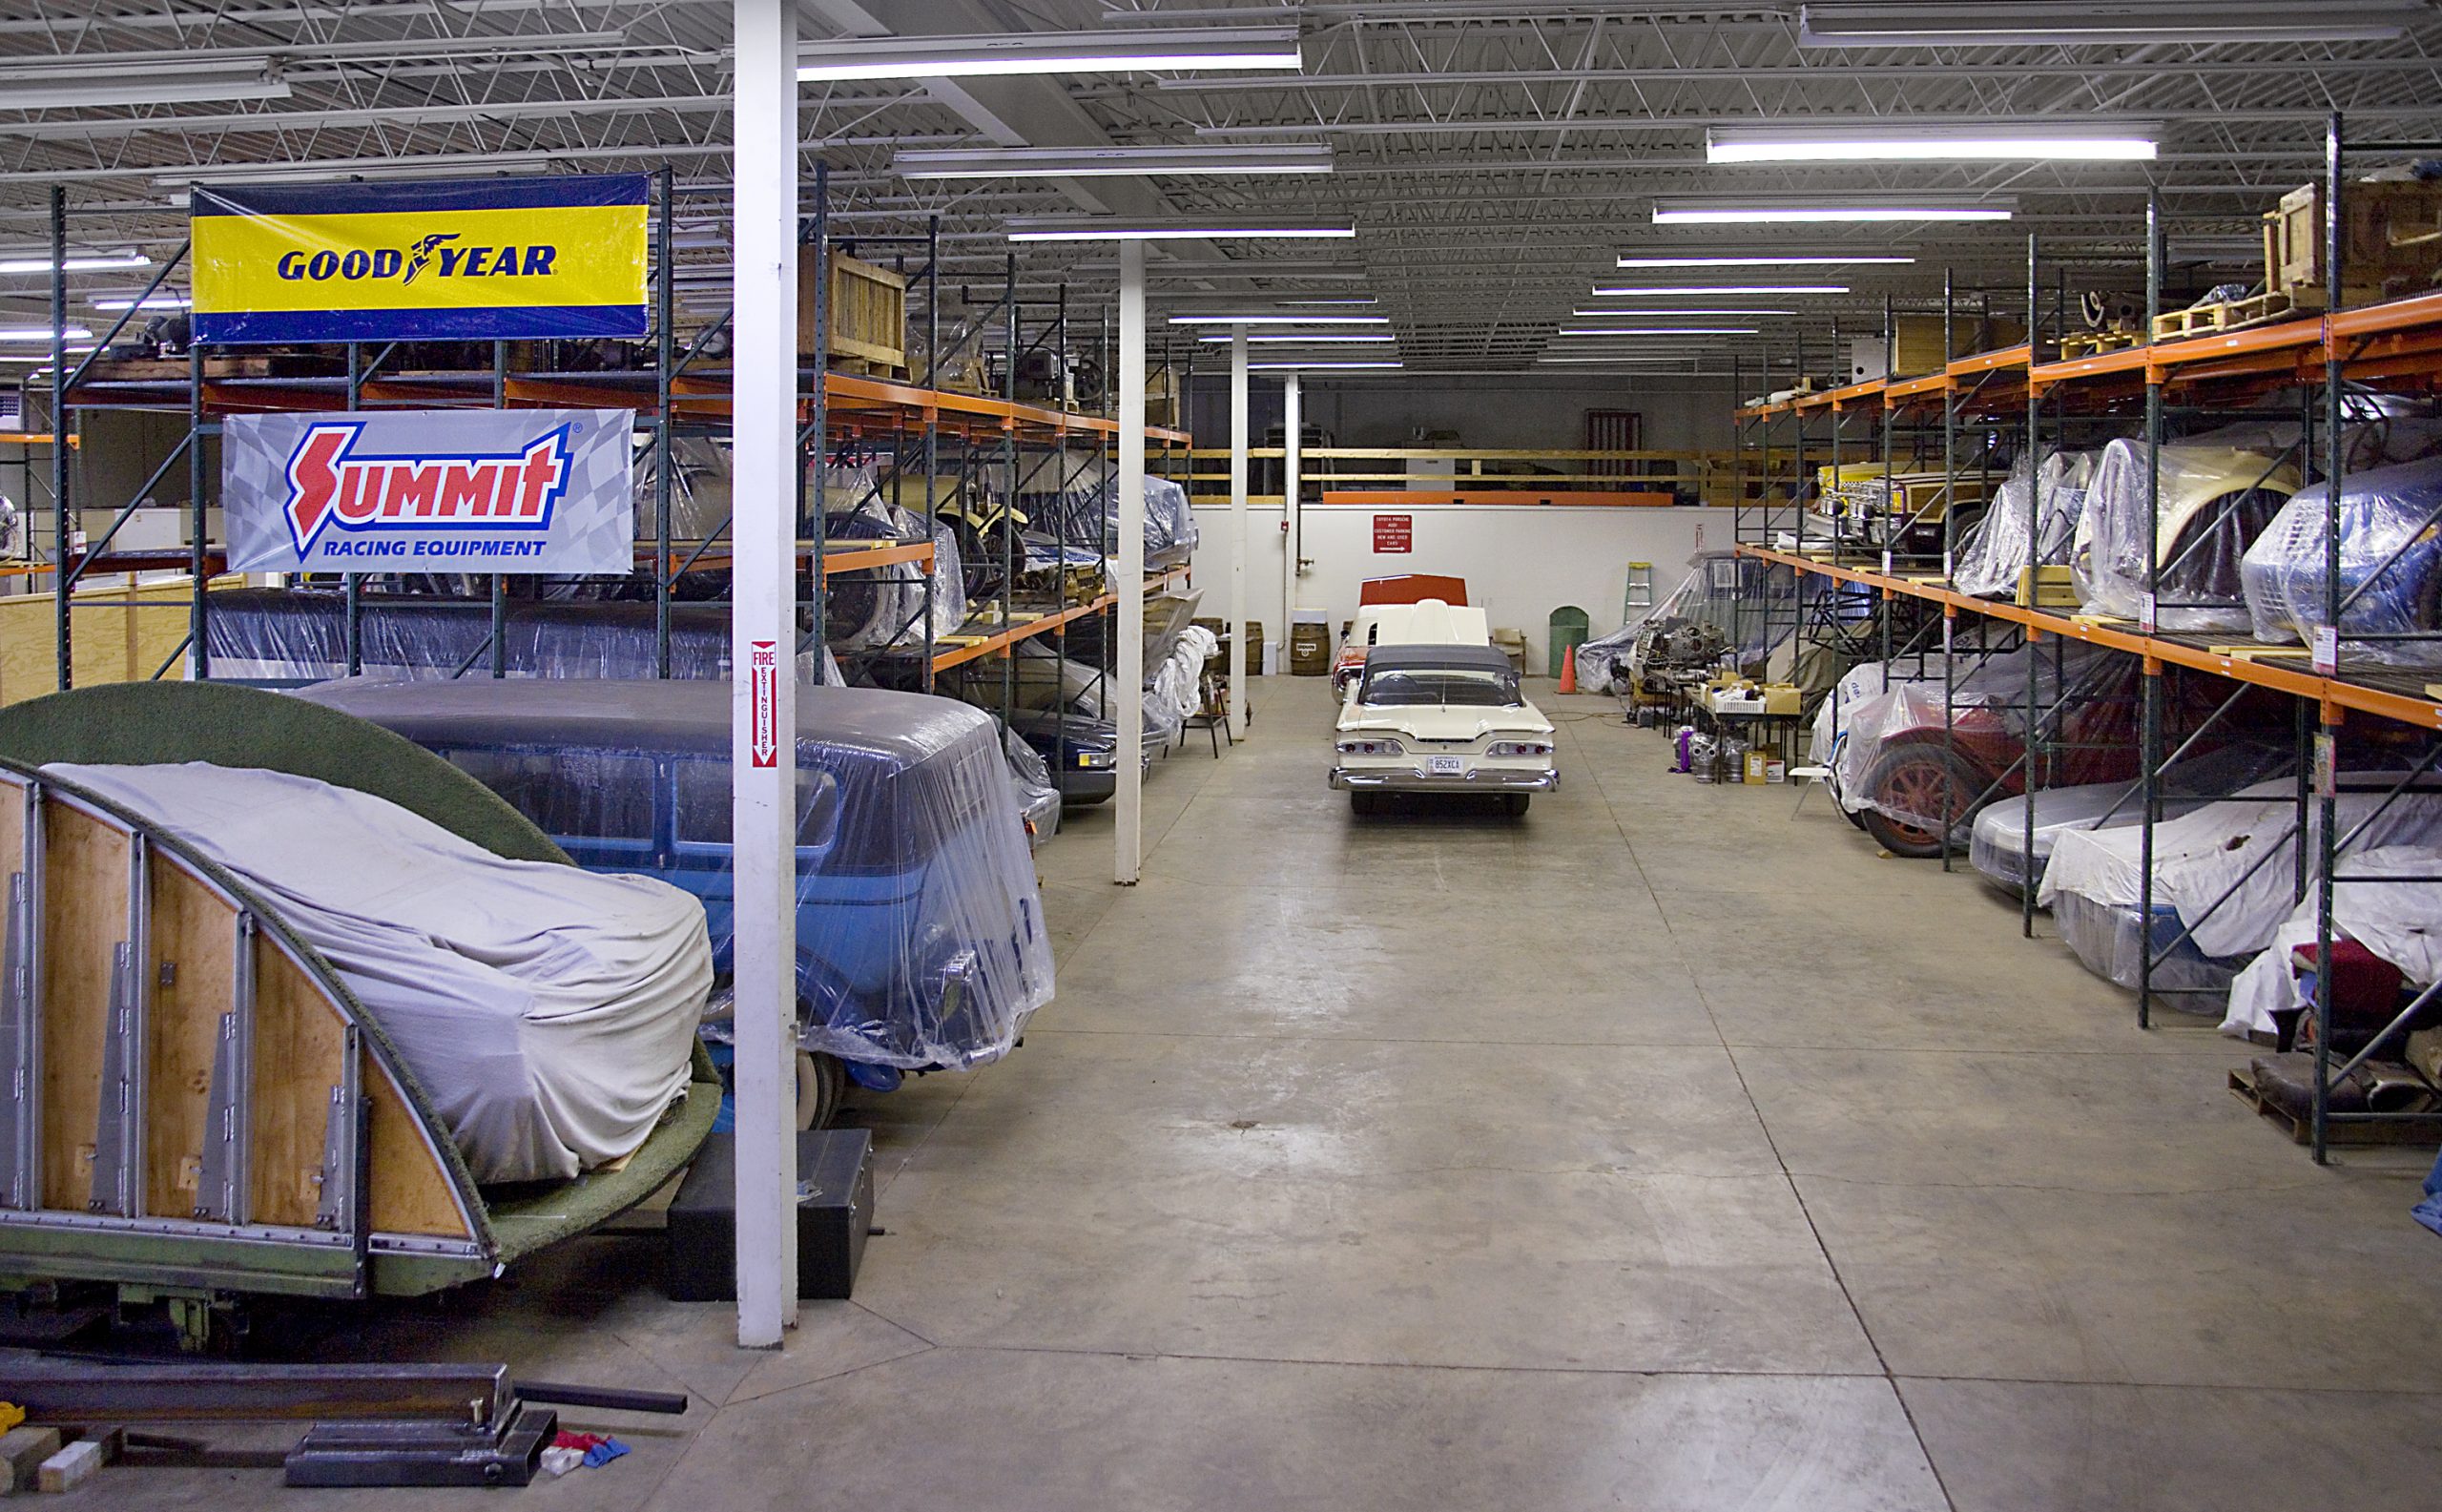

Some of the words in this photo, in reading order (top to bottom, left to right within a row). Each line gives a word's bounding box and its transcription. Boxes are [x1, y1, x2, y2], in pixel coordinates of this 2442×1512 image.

[278, 249, 403, 280] GOOD
[439, 245, 557, 277] YEAR
[323, 541, 406, 556] RACING
[413, 540, 547, 556] EQUIPMENT
[754, 652, 775, 665] FIRE
